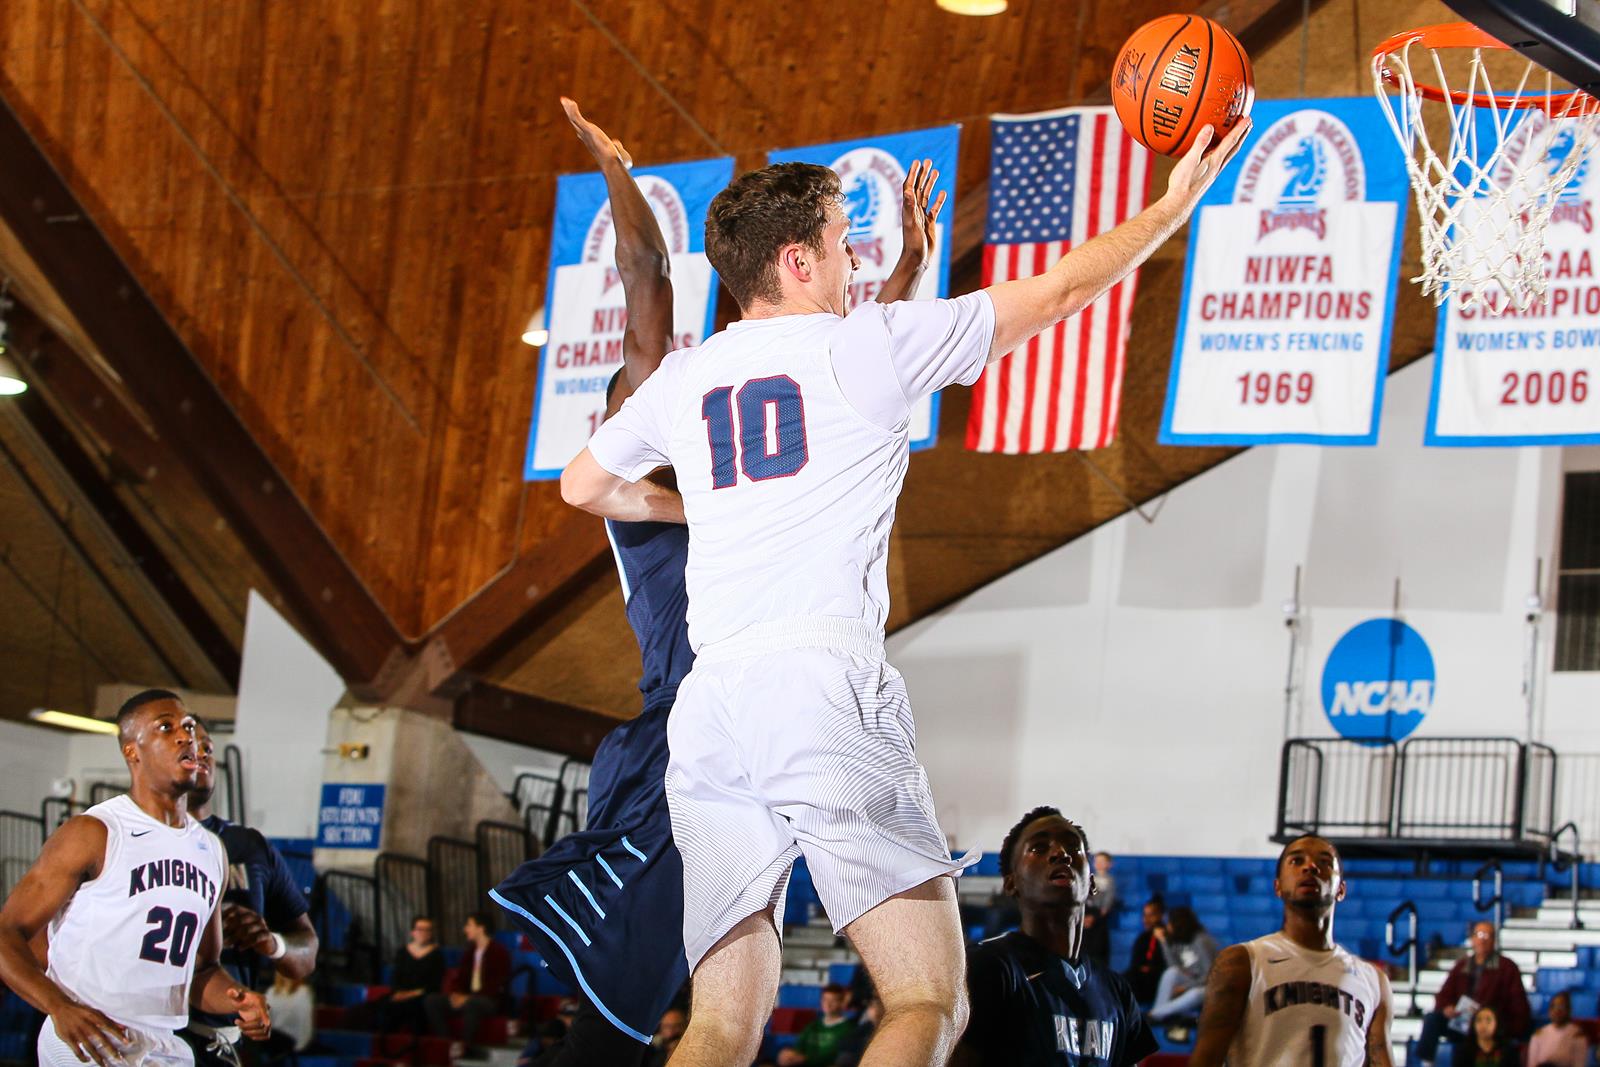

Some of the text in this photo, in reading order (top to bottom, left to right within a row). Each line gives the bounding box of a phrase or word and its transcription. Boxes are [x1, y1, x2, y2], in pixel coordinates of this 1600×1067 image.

[1153, 43, 1201, 138] THE ROCK
[1245, 255, 1334, 284] NIWFA
[1200, 291, 1372, 321] CHAMPIONS
[1200, 332, 1364, 351] WOMEN'S FENCING
[1457, 331, 1546, 351] WOMEN'S
[1237, 371, 1315, 405] 1969
[1500, 370, 1589, 405] 2006
[701, 373, 810, 490] 10
[1330, 680, 1430, 717] NCAA
[128, 858, 216, 909] KNIGHTS
[139, 905, 198, 968] 20
[1264, 981, 1366, 1029] KNIGHTS
[1054, 1014, 1114, 1060] KEAN
